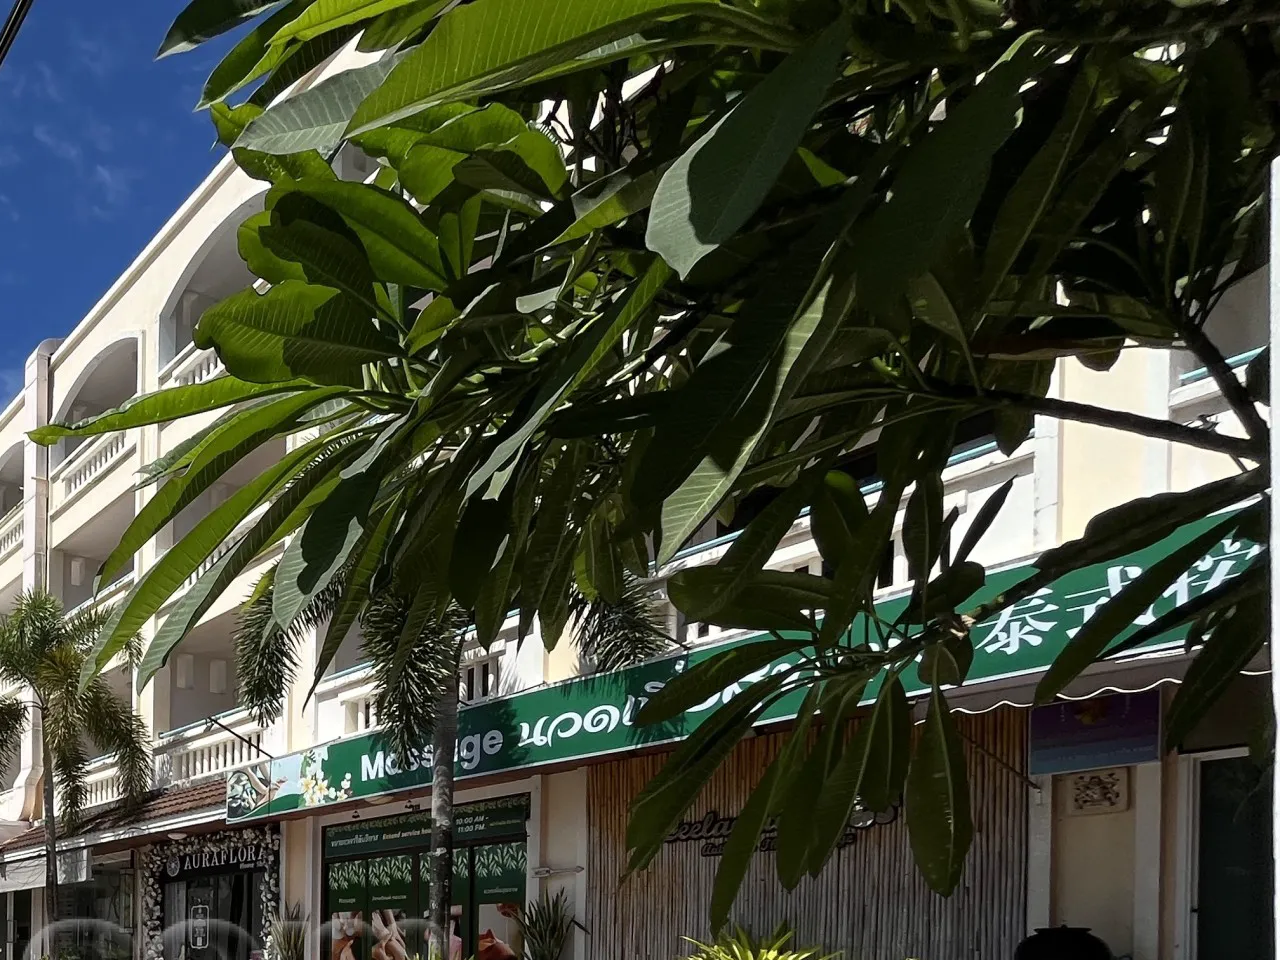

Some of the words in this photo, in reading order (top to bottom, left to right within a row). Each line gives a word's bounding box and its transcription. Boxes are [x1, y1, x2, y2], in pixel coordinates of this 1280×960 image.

[361, 729, 504, 782] Massge
[455, 816, 474, 826] 10:00
[474, 815, 485, 823] AM
[457, 825, 474, 833] 11:00
